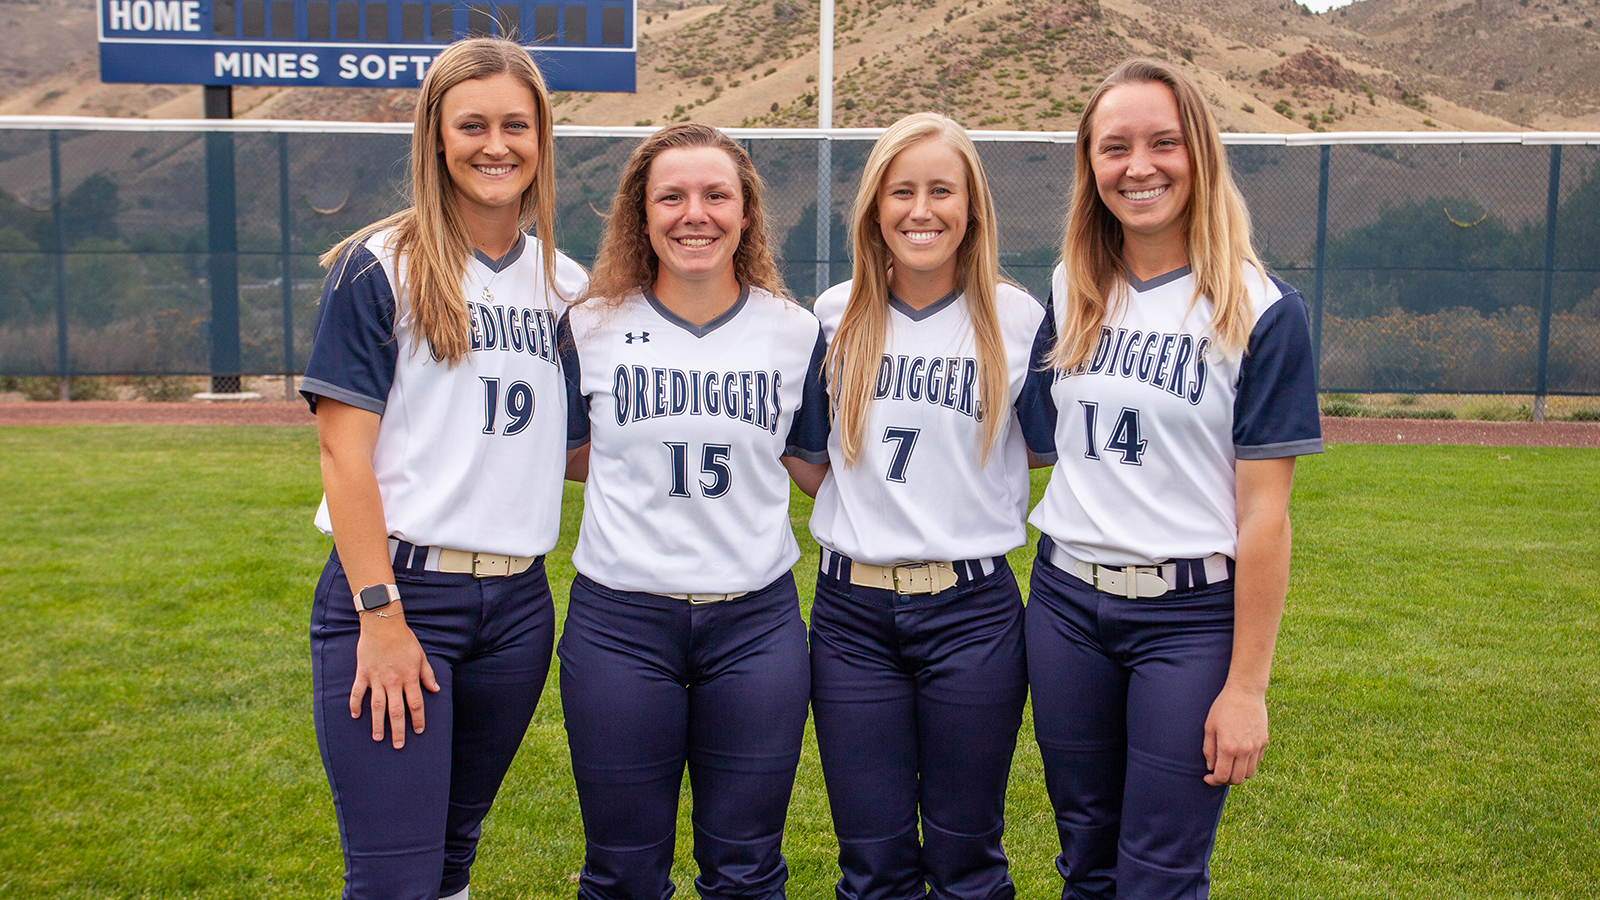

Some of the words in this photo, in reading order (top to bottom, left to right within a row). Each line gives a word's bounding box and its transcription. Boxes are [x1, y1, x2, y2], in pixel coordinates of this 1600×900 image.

[109, 0, 201, 31] HOME
[214, 51, 320, 80] MINES
[338, 53, 440, 80] SOFT
[427, 300, 559, 367] EDIGGER
[831, 352, 988, 423] DIGGER
[1054, 325, 1212, 406] DIGGERS
[478, 376, 536, 436] 19
[612, 364, 782, 435] OREDIGGERS
[882, 426, 921, 483] 7
[1078, 400, 1148, 466] 14
[662, 441, 732, 499] 15
